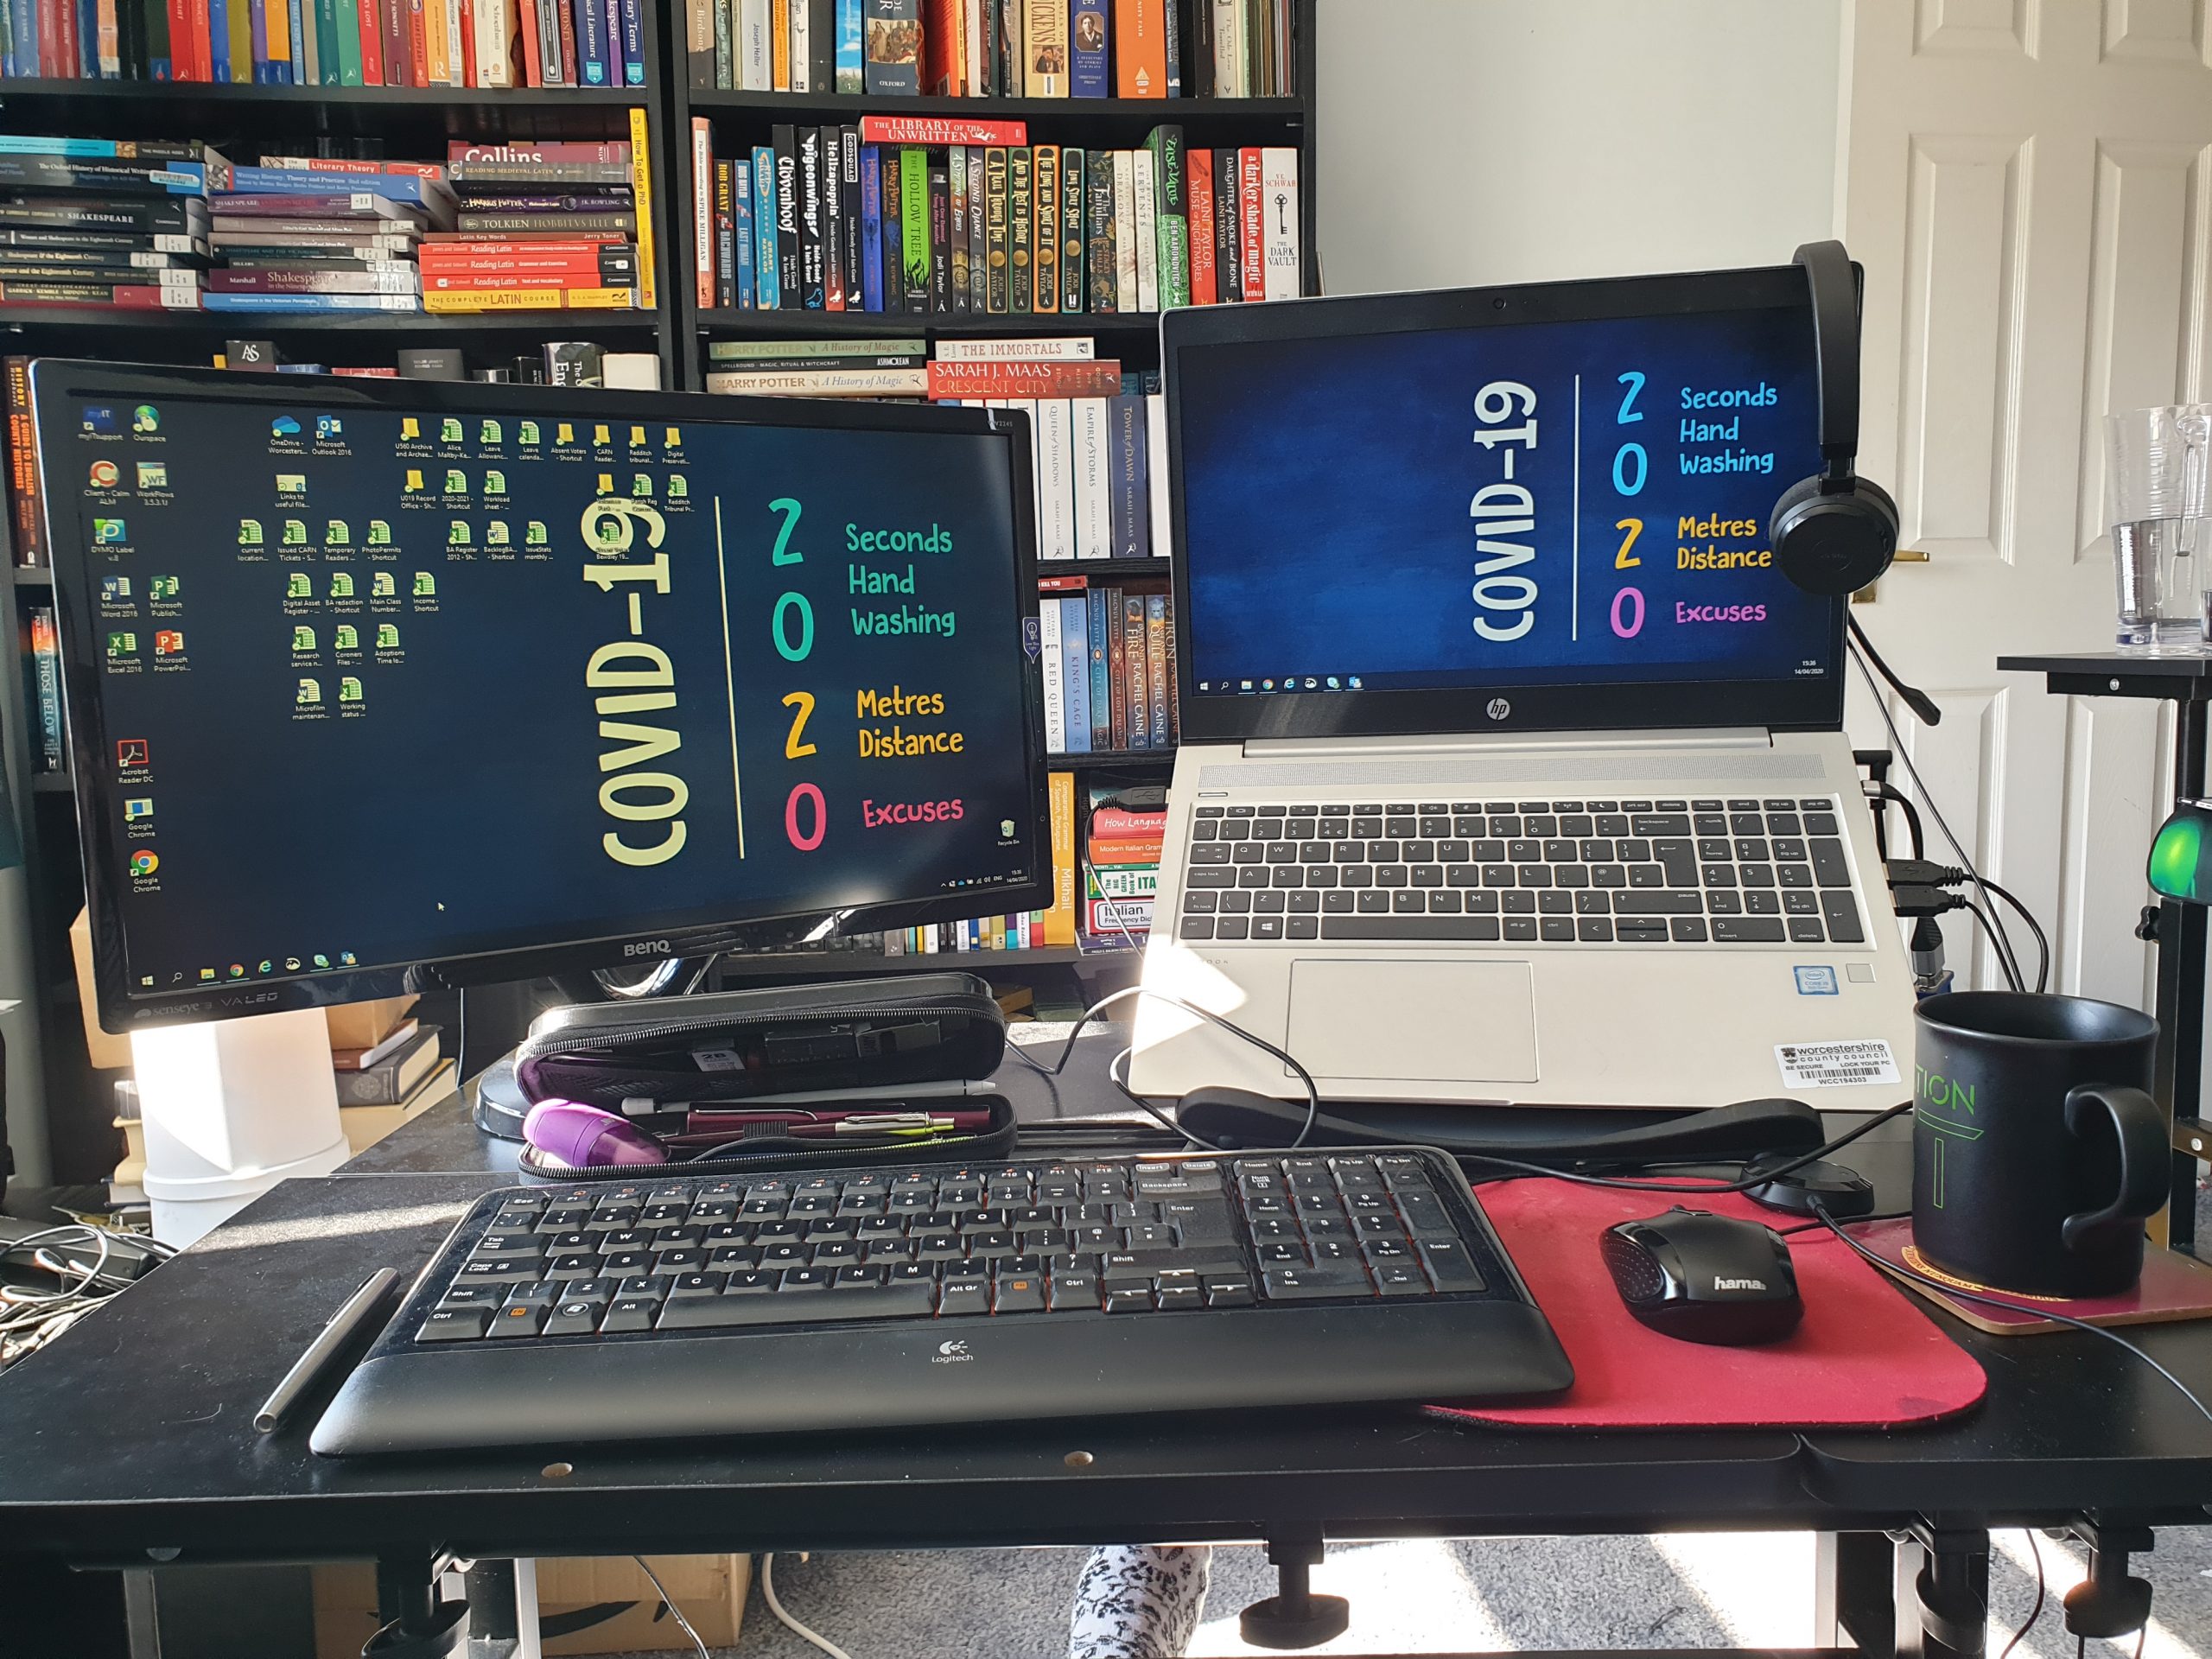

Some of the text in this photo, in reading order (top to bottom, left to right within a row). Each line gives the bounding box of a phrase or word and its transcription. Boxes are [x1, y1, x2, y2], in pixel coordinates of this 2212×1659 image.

[588, 18, 596, 58] Literature
[888, 130, 968, 141] UNWRITTEN
[893, 120, 951, 130] LIBRARY
[347, 163, 375, 173] Theory
[465, 147, 542, 162] Collins
[718, 164, 729, 212] ROB GRANT
[802, 143, 819, 226] pigeonwings
[1138, 164, 1147, 226] SERPENTS
[1225, 157, 1234, 206] DAUGHTER
[1245, 162, 1258, 199] darker
[67, 213, 134, 223] SHAKESPEARE
[482, 219, 530, 228] TOLKIEN
[909, 175, 921, 257] HOLLOW TREE
[1190, 180, 1202, 283] MUSE NIGHTMARES
[1200, 191, 1211, 270] LAINI TAYLOR
[1227, 214, 1236, 245] SMOKE
[1246, 201, 1260, 237] shade
[471, 245, 493, 253] Reading
[739, 228, 748, 242] LAST
[471, 260, 496, 269] Reading
[720, 232, 732, 280] BACKWARDS
[1170, 236, 1180, 288] AARONOVITCH
[1245, 249, 1260, 283] magic
[1268, 257, 1297, 266] VAULT
[1270, 247, 1294, 257] DARK
[474, 276, 499, 286] Reading
[490, 294, 521, 304] LATIN
[875, 343, 899, 352] Magic
[962, 344, 1062, 356] THE IMMORTALS
[759, 378, 805, 387] POTTER
[832, 376, 903, 387] History Magic
[936, 364, 1052, 379] SARAH J. MAAS
[936, 380, 1048, 393] CRESCENT CITY
[1618, 372, 1646, 424] 2
[1681, 382, 1777, 410] Seconds
[1680, 416, 1739, 442] Hand
[1051, 445, 1059, 487] SHADOWS
[1125, 448, 1135, 481] DAWN
[1612, 442, 1648, 496] 0
[1680, 448, 1774, 475] Washing
[1470, 381, 1538, 642] COVID-19
[1678, 512, 1757, 540] Metres
[767, 498, 804, 566] 2
[846, 524, 952, 553] Seconds
[1614, 518, 1643, 569] 2
[1676, 546, 1772, 569] Distance
[849, 564, 915, 594] Hand
[772, 591, 814, 661] 0
[851, 605, 955, 637] Washing
[1610, 587, 1645, 639] 0
[1675, 601, 1767, 624] Excuses
[1128, 628, 1139, 658] FIRE
[1149, 624, 1159, 658] QUILL
[581, 498, 689, 867] COVID-19
[1071, 656, 1080, 694] KING'S
[40, 658, 55, 737] THOSE BELOW
[856, 685, 944, 718] Metres
[1048, 663, 1058, 734] RED QUEEN
[1133, 663, 1144, 737] RACHEL CAINE
[1154, 662, 1165, 735] RACHEL CAINE
[782, 691, 817, 760] 2
[859, 726, 963, 759] Distance
[128, 823, 153, 831] Google
[785, 783, 826, 851] 0
[863, 797, 963, 828] Excuses
[1105, 818, 1125, 828] How
[134, 877, 158, 886] Google
[1062, 868, 1071, 910] Mikhail
[1797, 1042, 1885, 1055] worcestershire
[1800, 1051, 1888, 1063] county council
[1141, 1181, 1188, 1190] Backspace
[931, 1354, 974, 1363] Logitech
